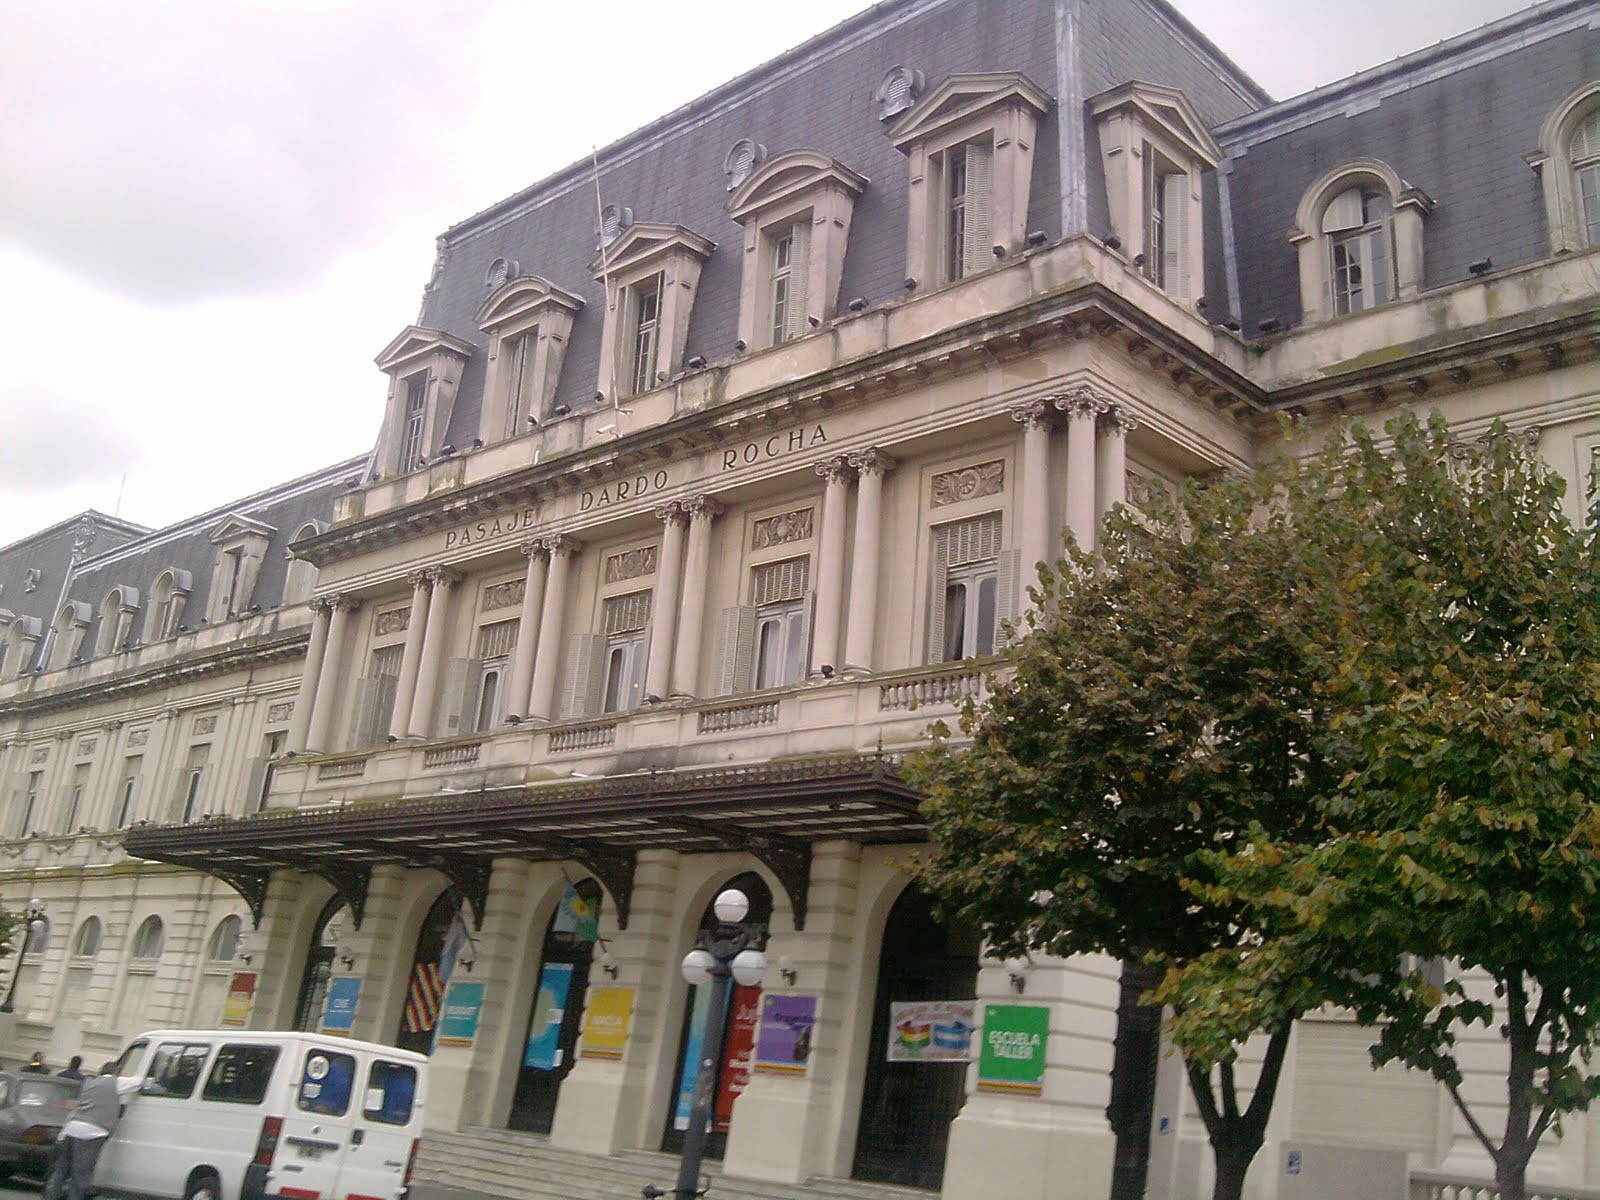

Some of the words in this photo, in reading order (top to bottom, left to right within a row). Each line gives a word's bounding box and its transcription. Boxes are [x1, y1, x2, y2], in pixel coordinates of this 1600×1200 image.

[445, 508, 535, 549] PASAJE
[580, 471, 669, 512] DARDO
[721, 424, 828, 470] ROCHA
[988, 1030, 1040, 1046] ESCUELA
